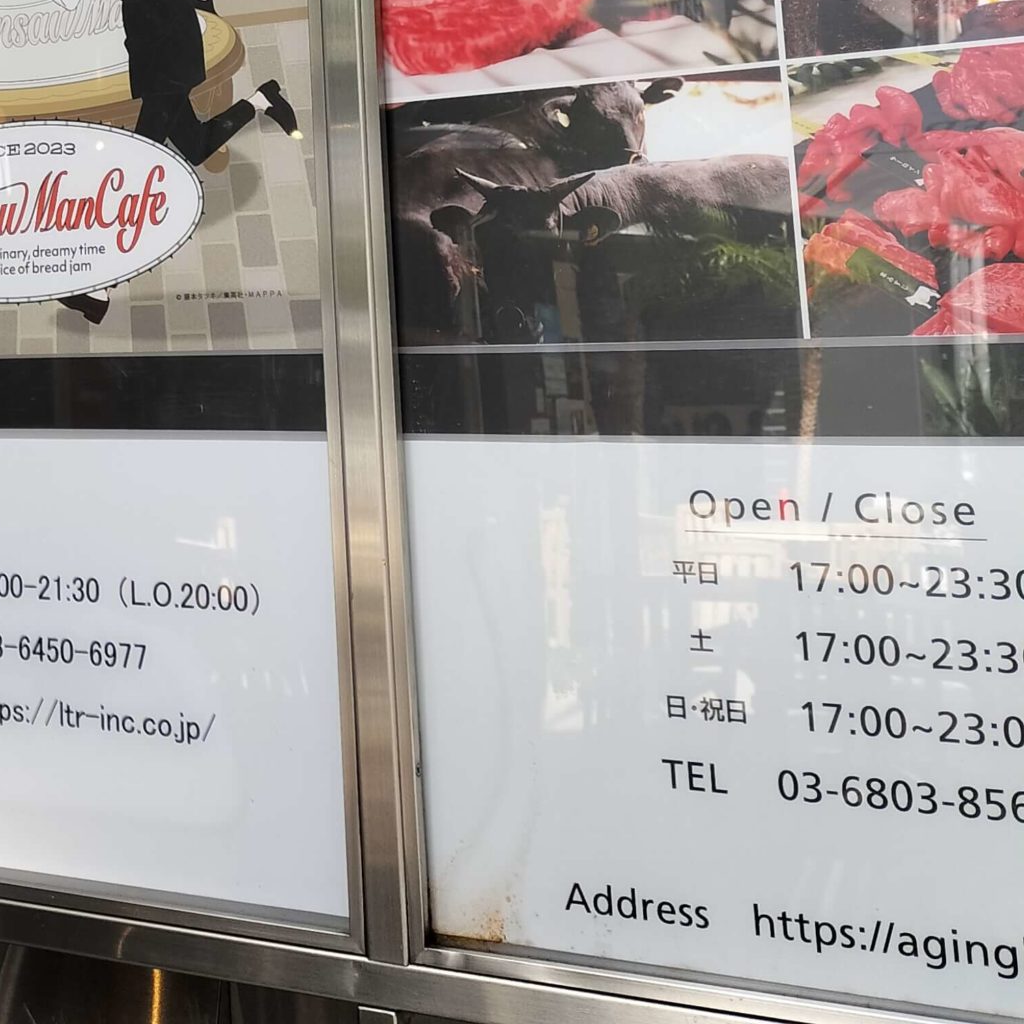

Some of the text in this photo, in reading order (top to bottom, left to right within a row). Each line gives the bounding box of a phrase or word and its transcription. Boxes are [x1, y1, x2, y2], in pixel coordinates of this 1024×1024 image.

[24, 142, 76, 156] 2023
[32, 244, 77, 262] dreamy
[78, 242, 106, 257] time
[17, 261, 30, 275] of
[31, 259, 68, 275] bread
[68, 260, 92, 277] jam
[689, 489, 800, 527] Open
[854, 491, 976, 526] Close
[672, 560, 719, 585] 平日
[690, 629, 1024, 674] 土 17:00~23:3
[662, 759, 728, 794] TEL
[565, 882, 1024, 980] Address https://aging
